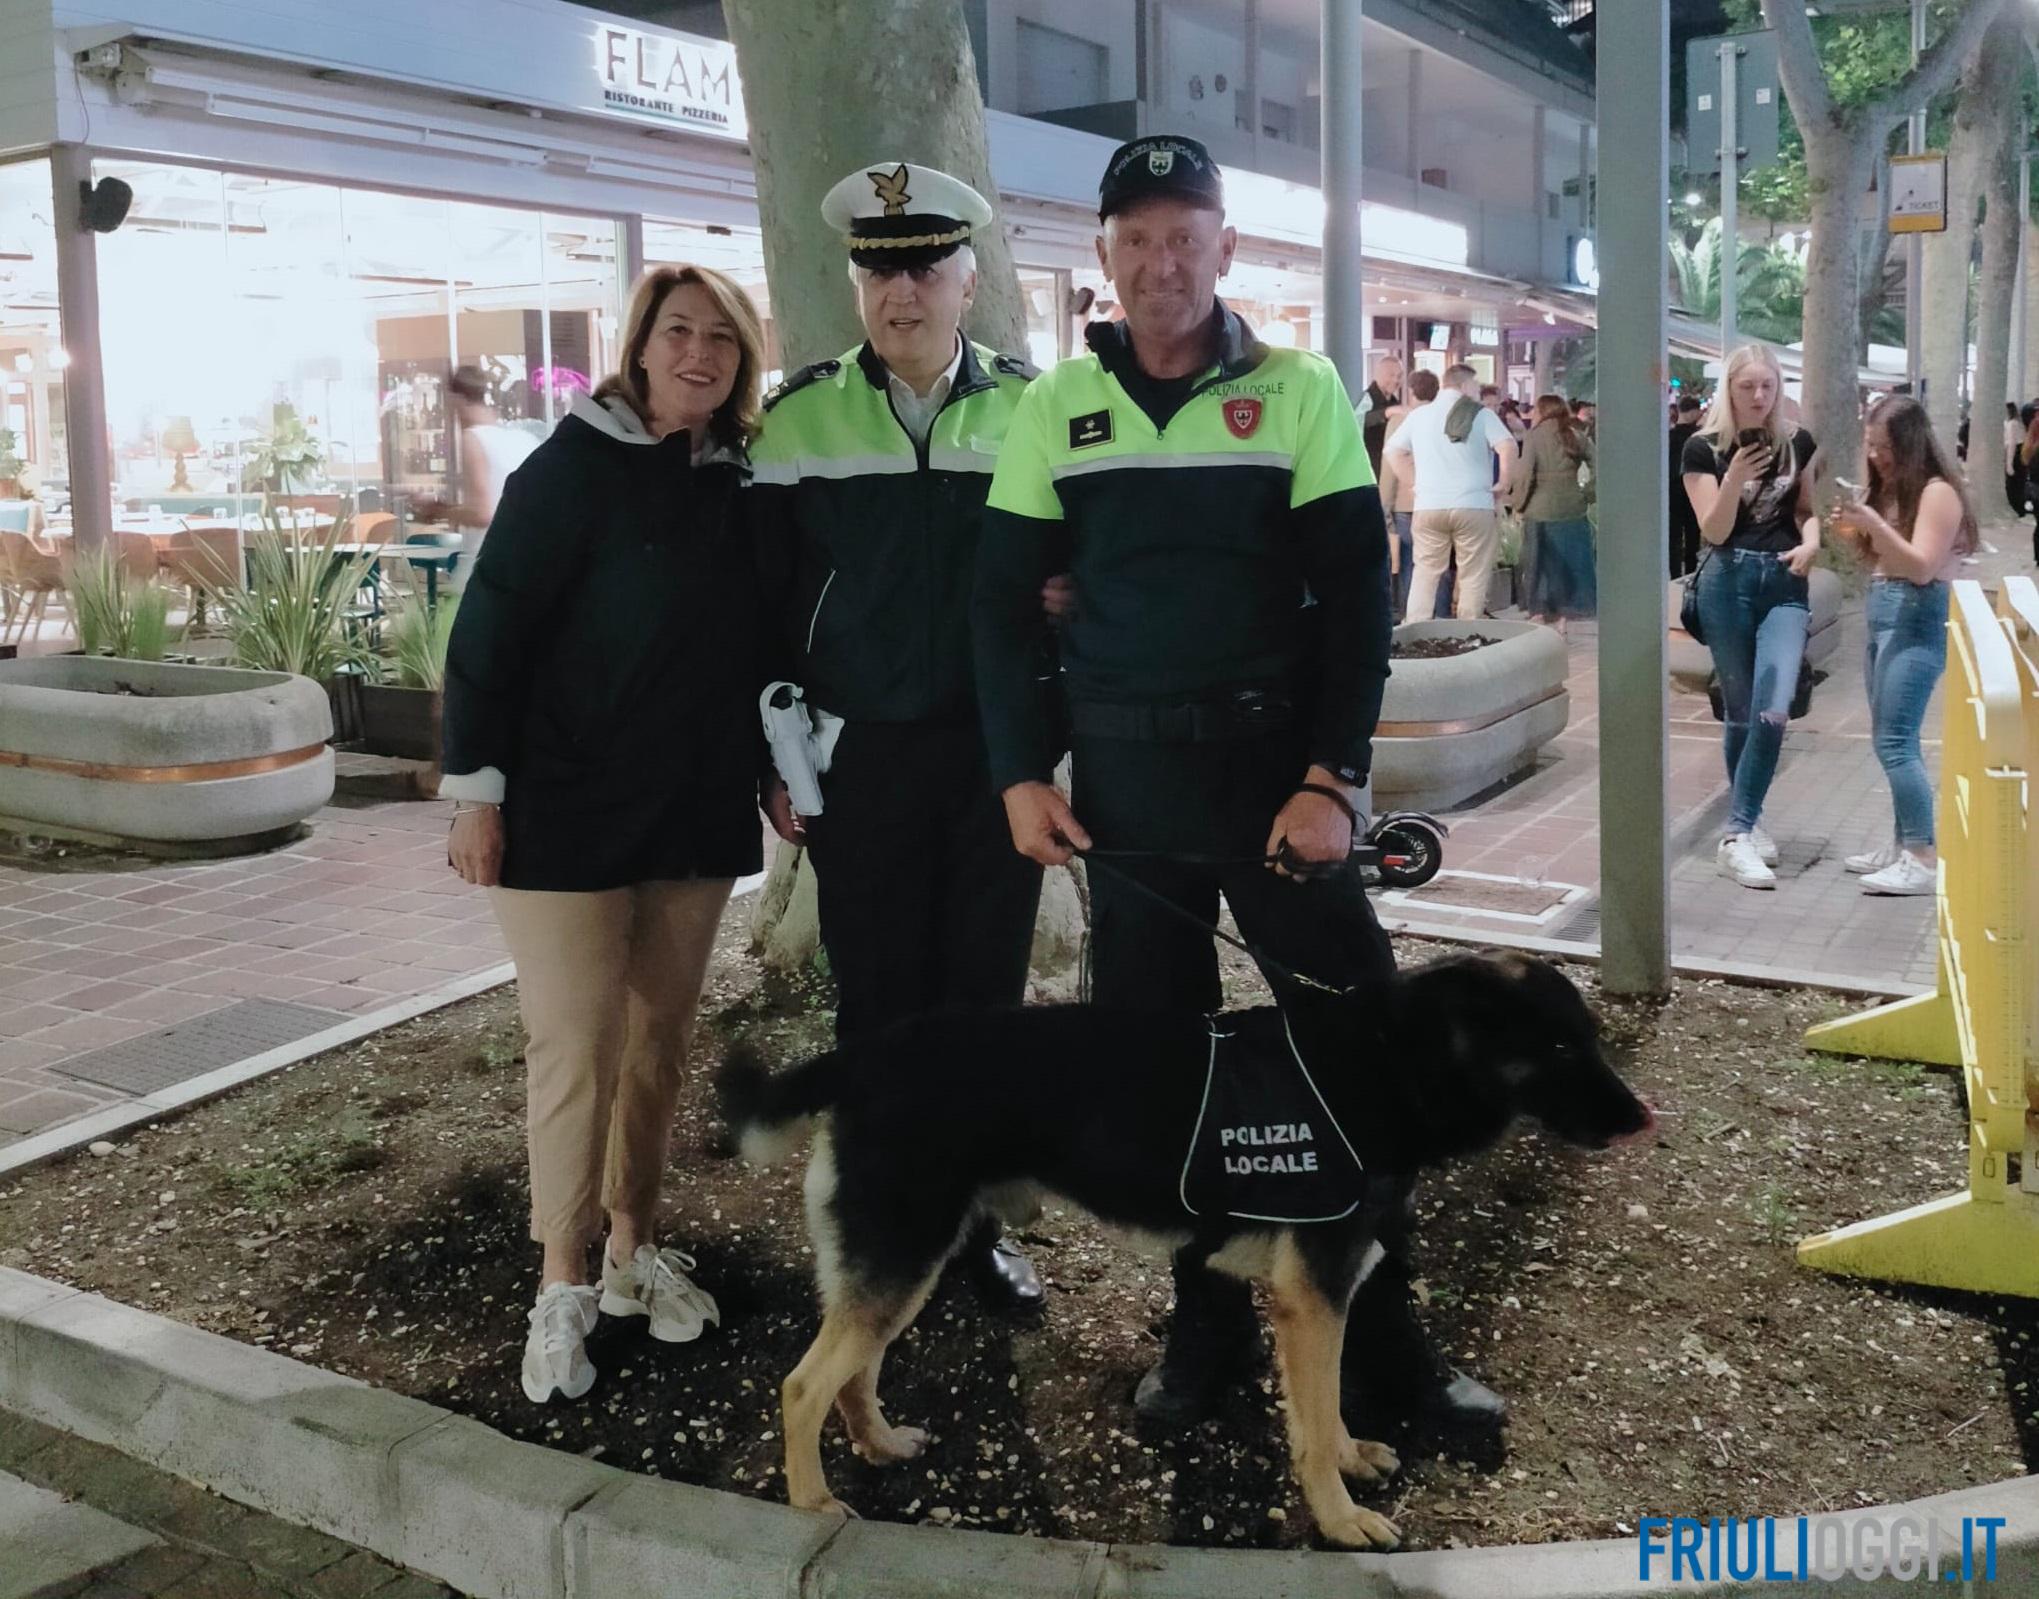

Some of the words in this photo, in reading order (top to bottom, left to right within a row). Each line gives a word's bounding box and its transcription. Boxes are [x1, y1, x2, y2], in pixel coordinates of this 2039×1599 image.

[606, 30, 730, 105] FLAM
[604, 90, 674, 113] RISTORANTE
[681, 106, 728, 123] PIZZERIA
[1243, 382, 1285, 396] LOCALE
[1220, 1122, 1314, 1147] POLIZIA
[1224, 1151, 1319, 1175] LOCALE
